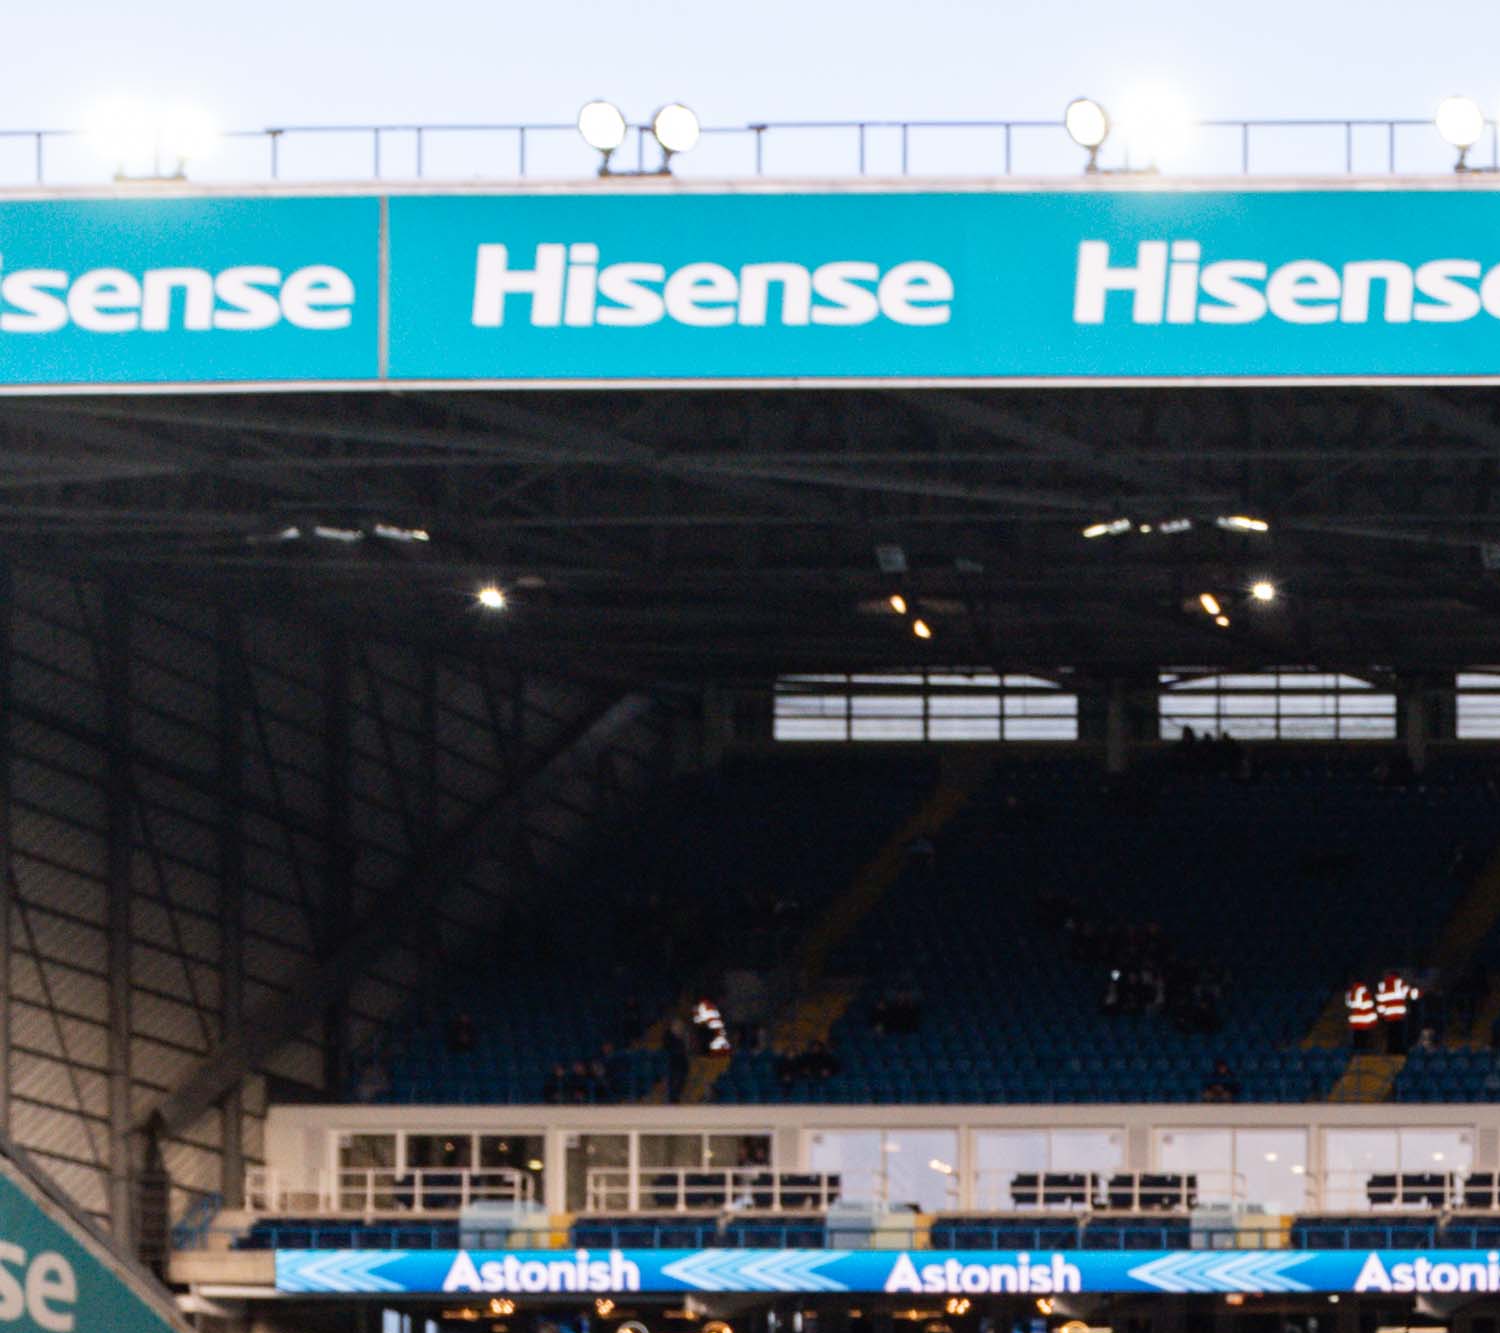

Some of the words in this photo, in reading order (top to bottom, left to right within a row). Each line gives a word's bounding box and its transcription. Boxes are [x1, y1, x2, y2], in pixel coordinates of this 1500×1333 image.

[472, 242, 954, 327] Hisense
[444, 1250, 639, 1292] Astonish
[886, 1253, 1080, 1293] Astonish
